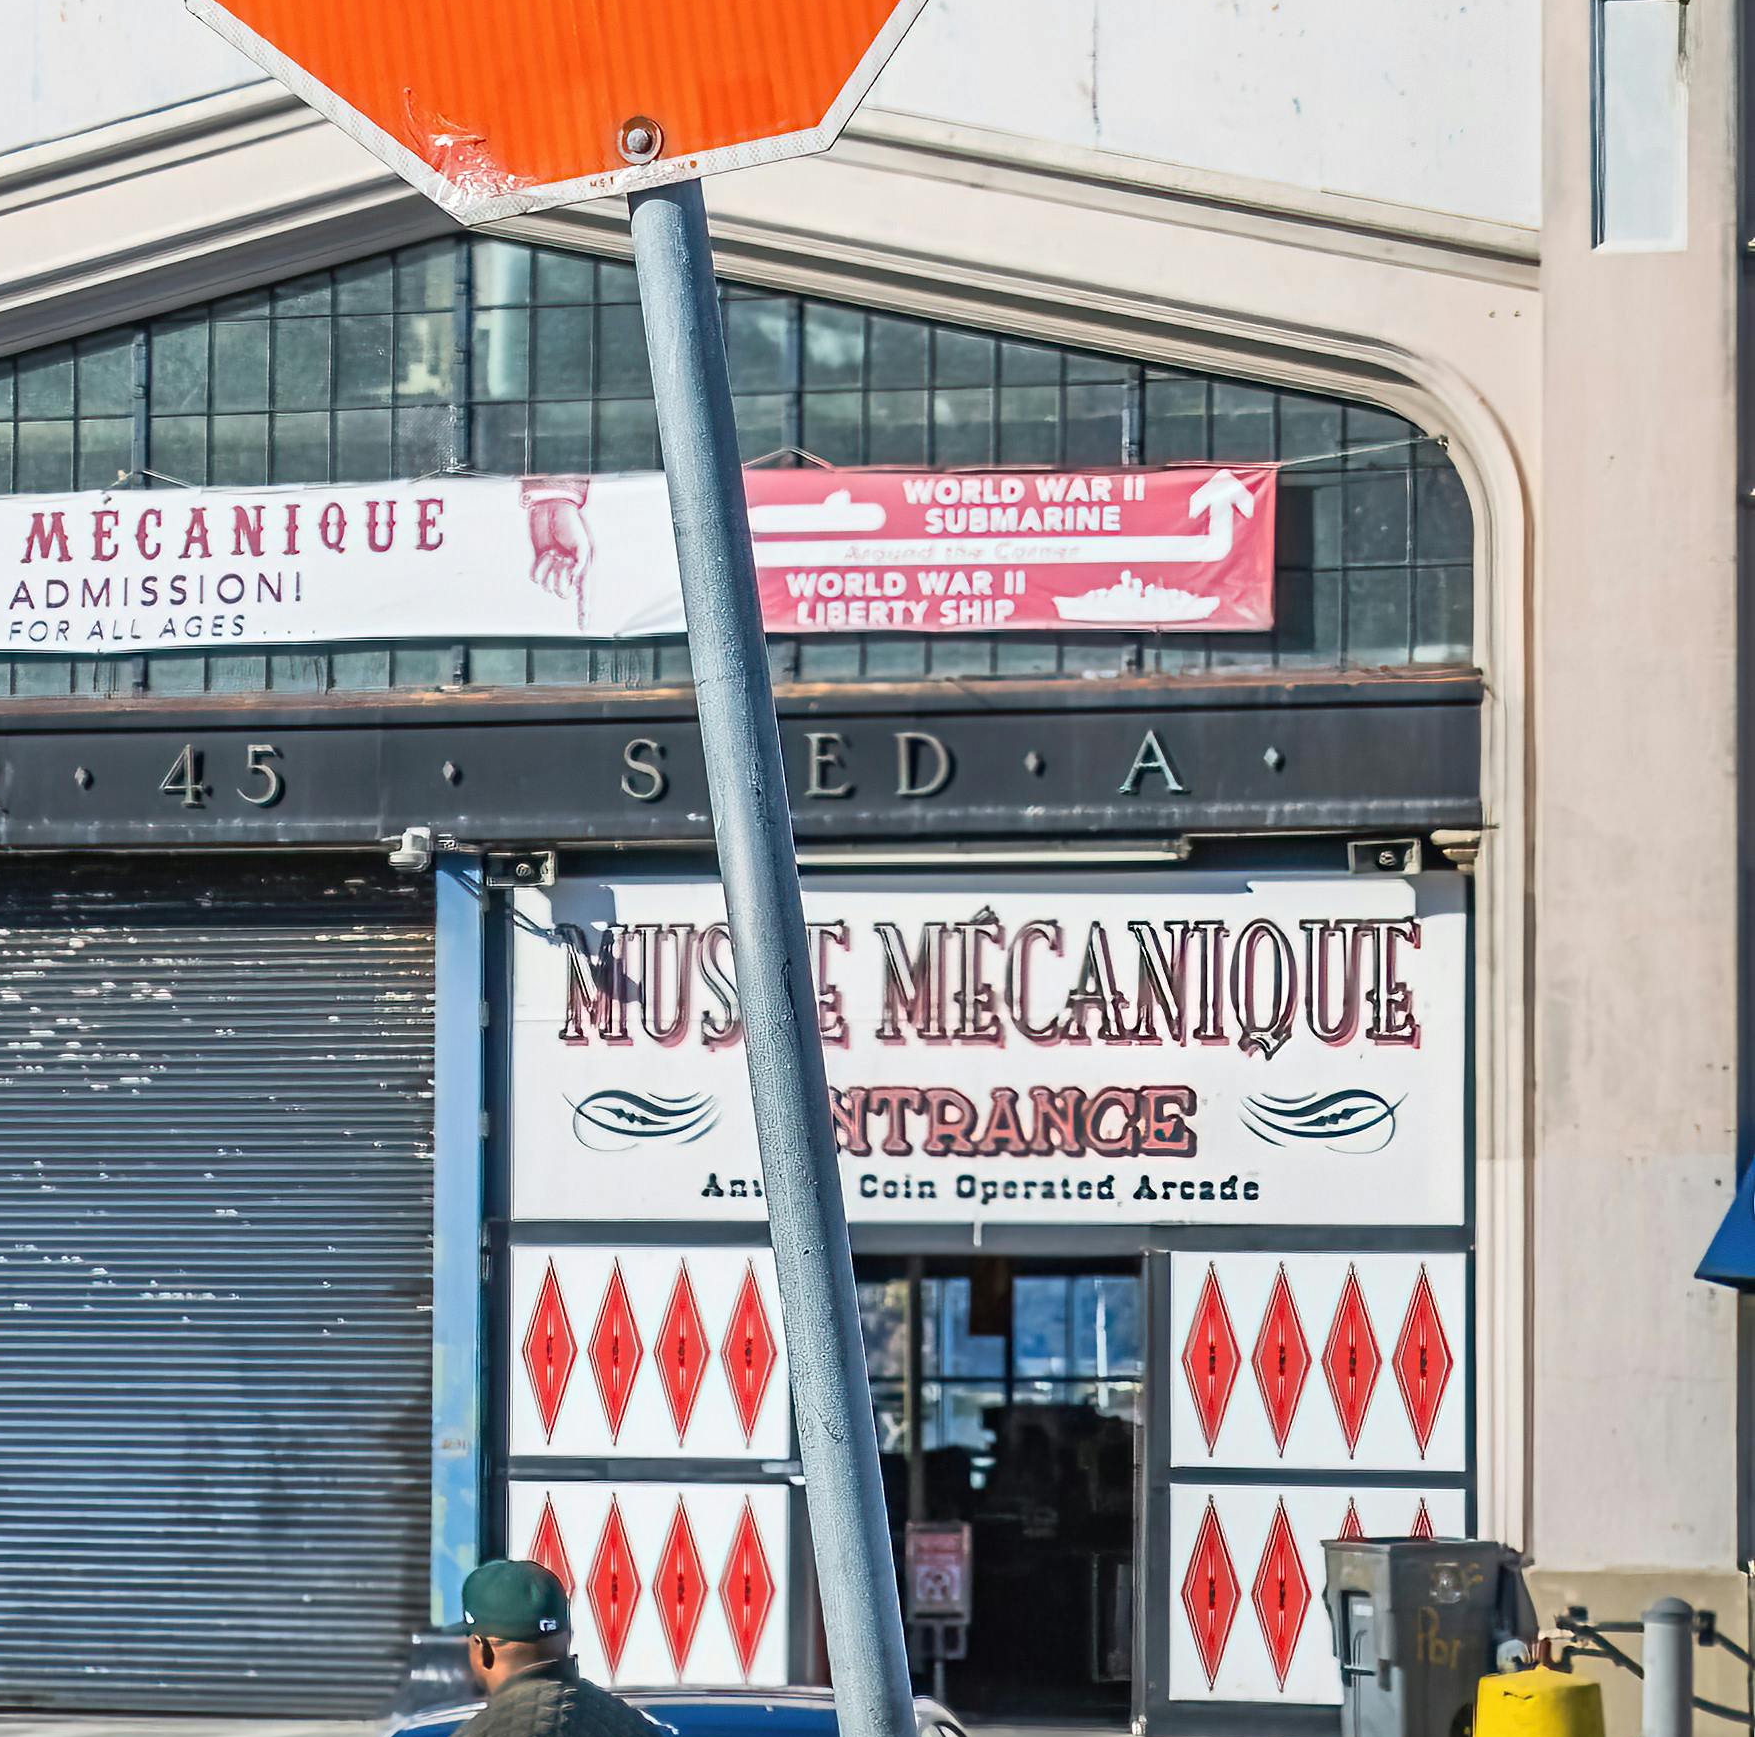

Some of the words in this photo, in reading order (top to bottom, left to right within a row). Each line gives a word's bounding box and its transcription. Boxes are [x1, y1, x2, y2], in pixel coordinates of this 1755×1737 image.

[902, 478, 1024, 505] WORLD
[1035, 476, 1115, 504] WAR
[1123, 474, 1145, 501] II
[20, 494, 446, 565] MÉCANIQUE
[924, 505, 1122, 534] SUBMARINE
[8, 572, 304, 611] ADMISSION!
[785, 570, 906, 599] WORLD
[917, 569, 999, 597] WAR
[1004, 568, 1026, 596] II
[8, 619, 70, 642] FOR
[87, 617, 143, 641] ALL
[159, 614, 246, 639] AGES
[796, 599, 927, 627] LIBERTY
[940, 598, 1016, 625] SHIP
[158, 742, 286, 809] 45
[619, 730, 955, 801] SED
[1117, 727, 1191, 796] A
[558, 917, 852, 1049] MUSE
[873, 905, 1422, 1061] MÉCANIQUE
[828, 1084, 1198, 1160] NTRANCE
[858, 1171, 938, 1200] Coin
[955, 1173, 1115, 1205] Operated
[1132, 1173, 1260, 1201] Arcade
